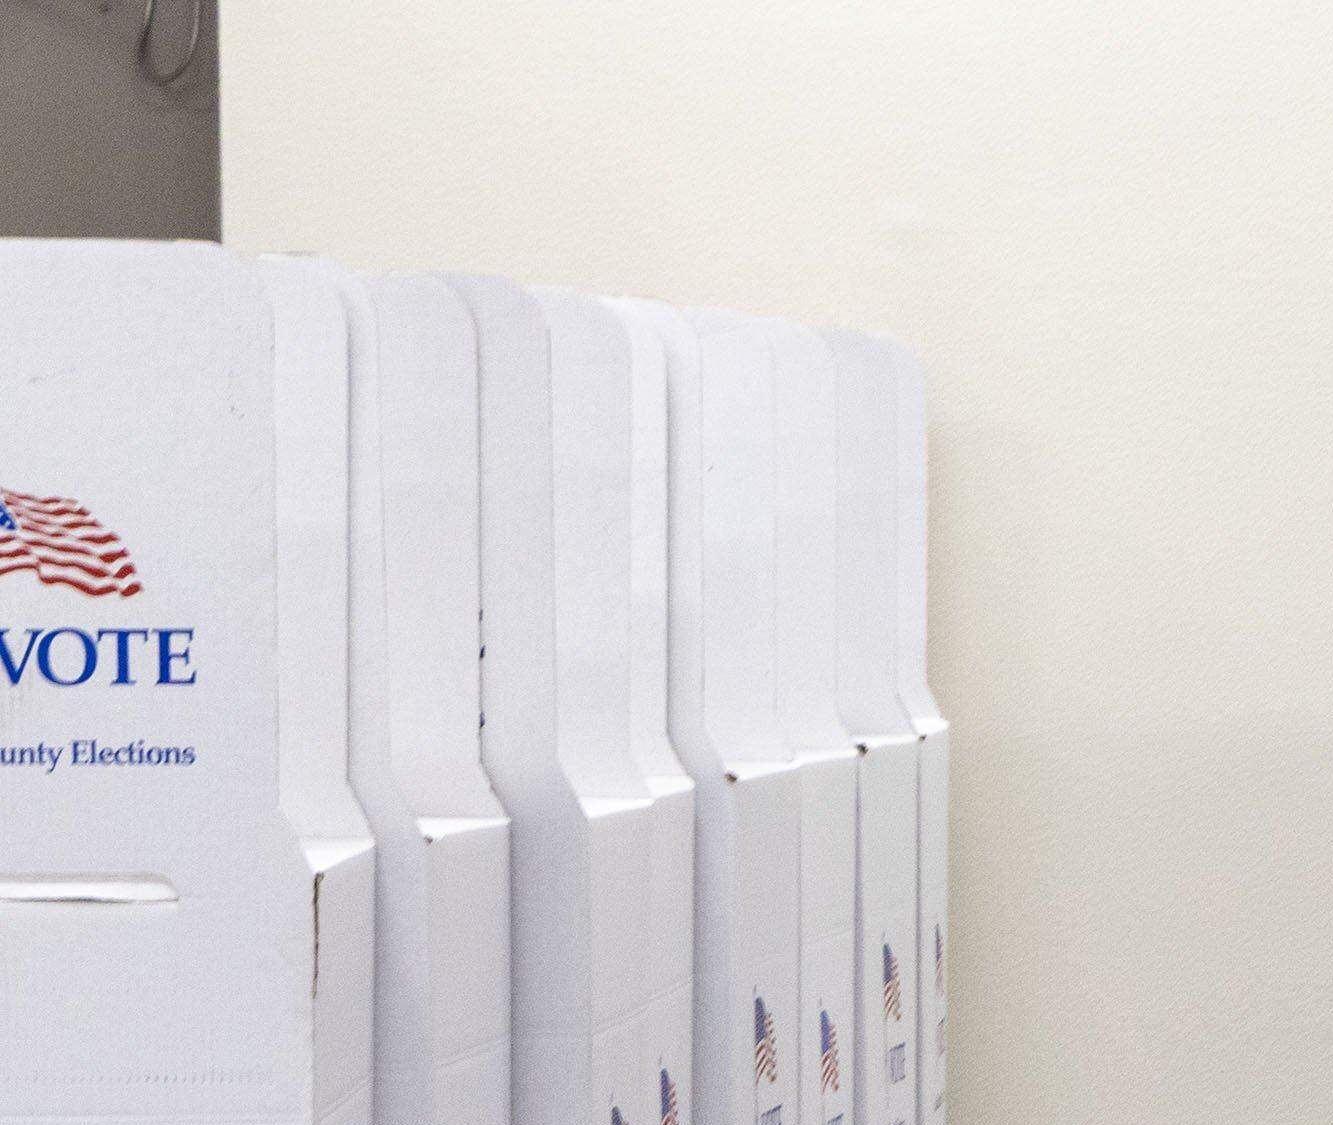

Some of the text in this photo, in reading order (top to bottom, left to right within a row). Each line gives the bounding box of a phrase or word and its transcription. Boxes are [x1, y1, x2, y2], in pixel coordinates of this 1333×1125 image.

[0, 626, 197, 686] VOTE
[0, 739, 197, 774] unty Elections
